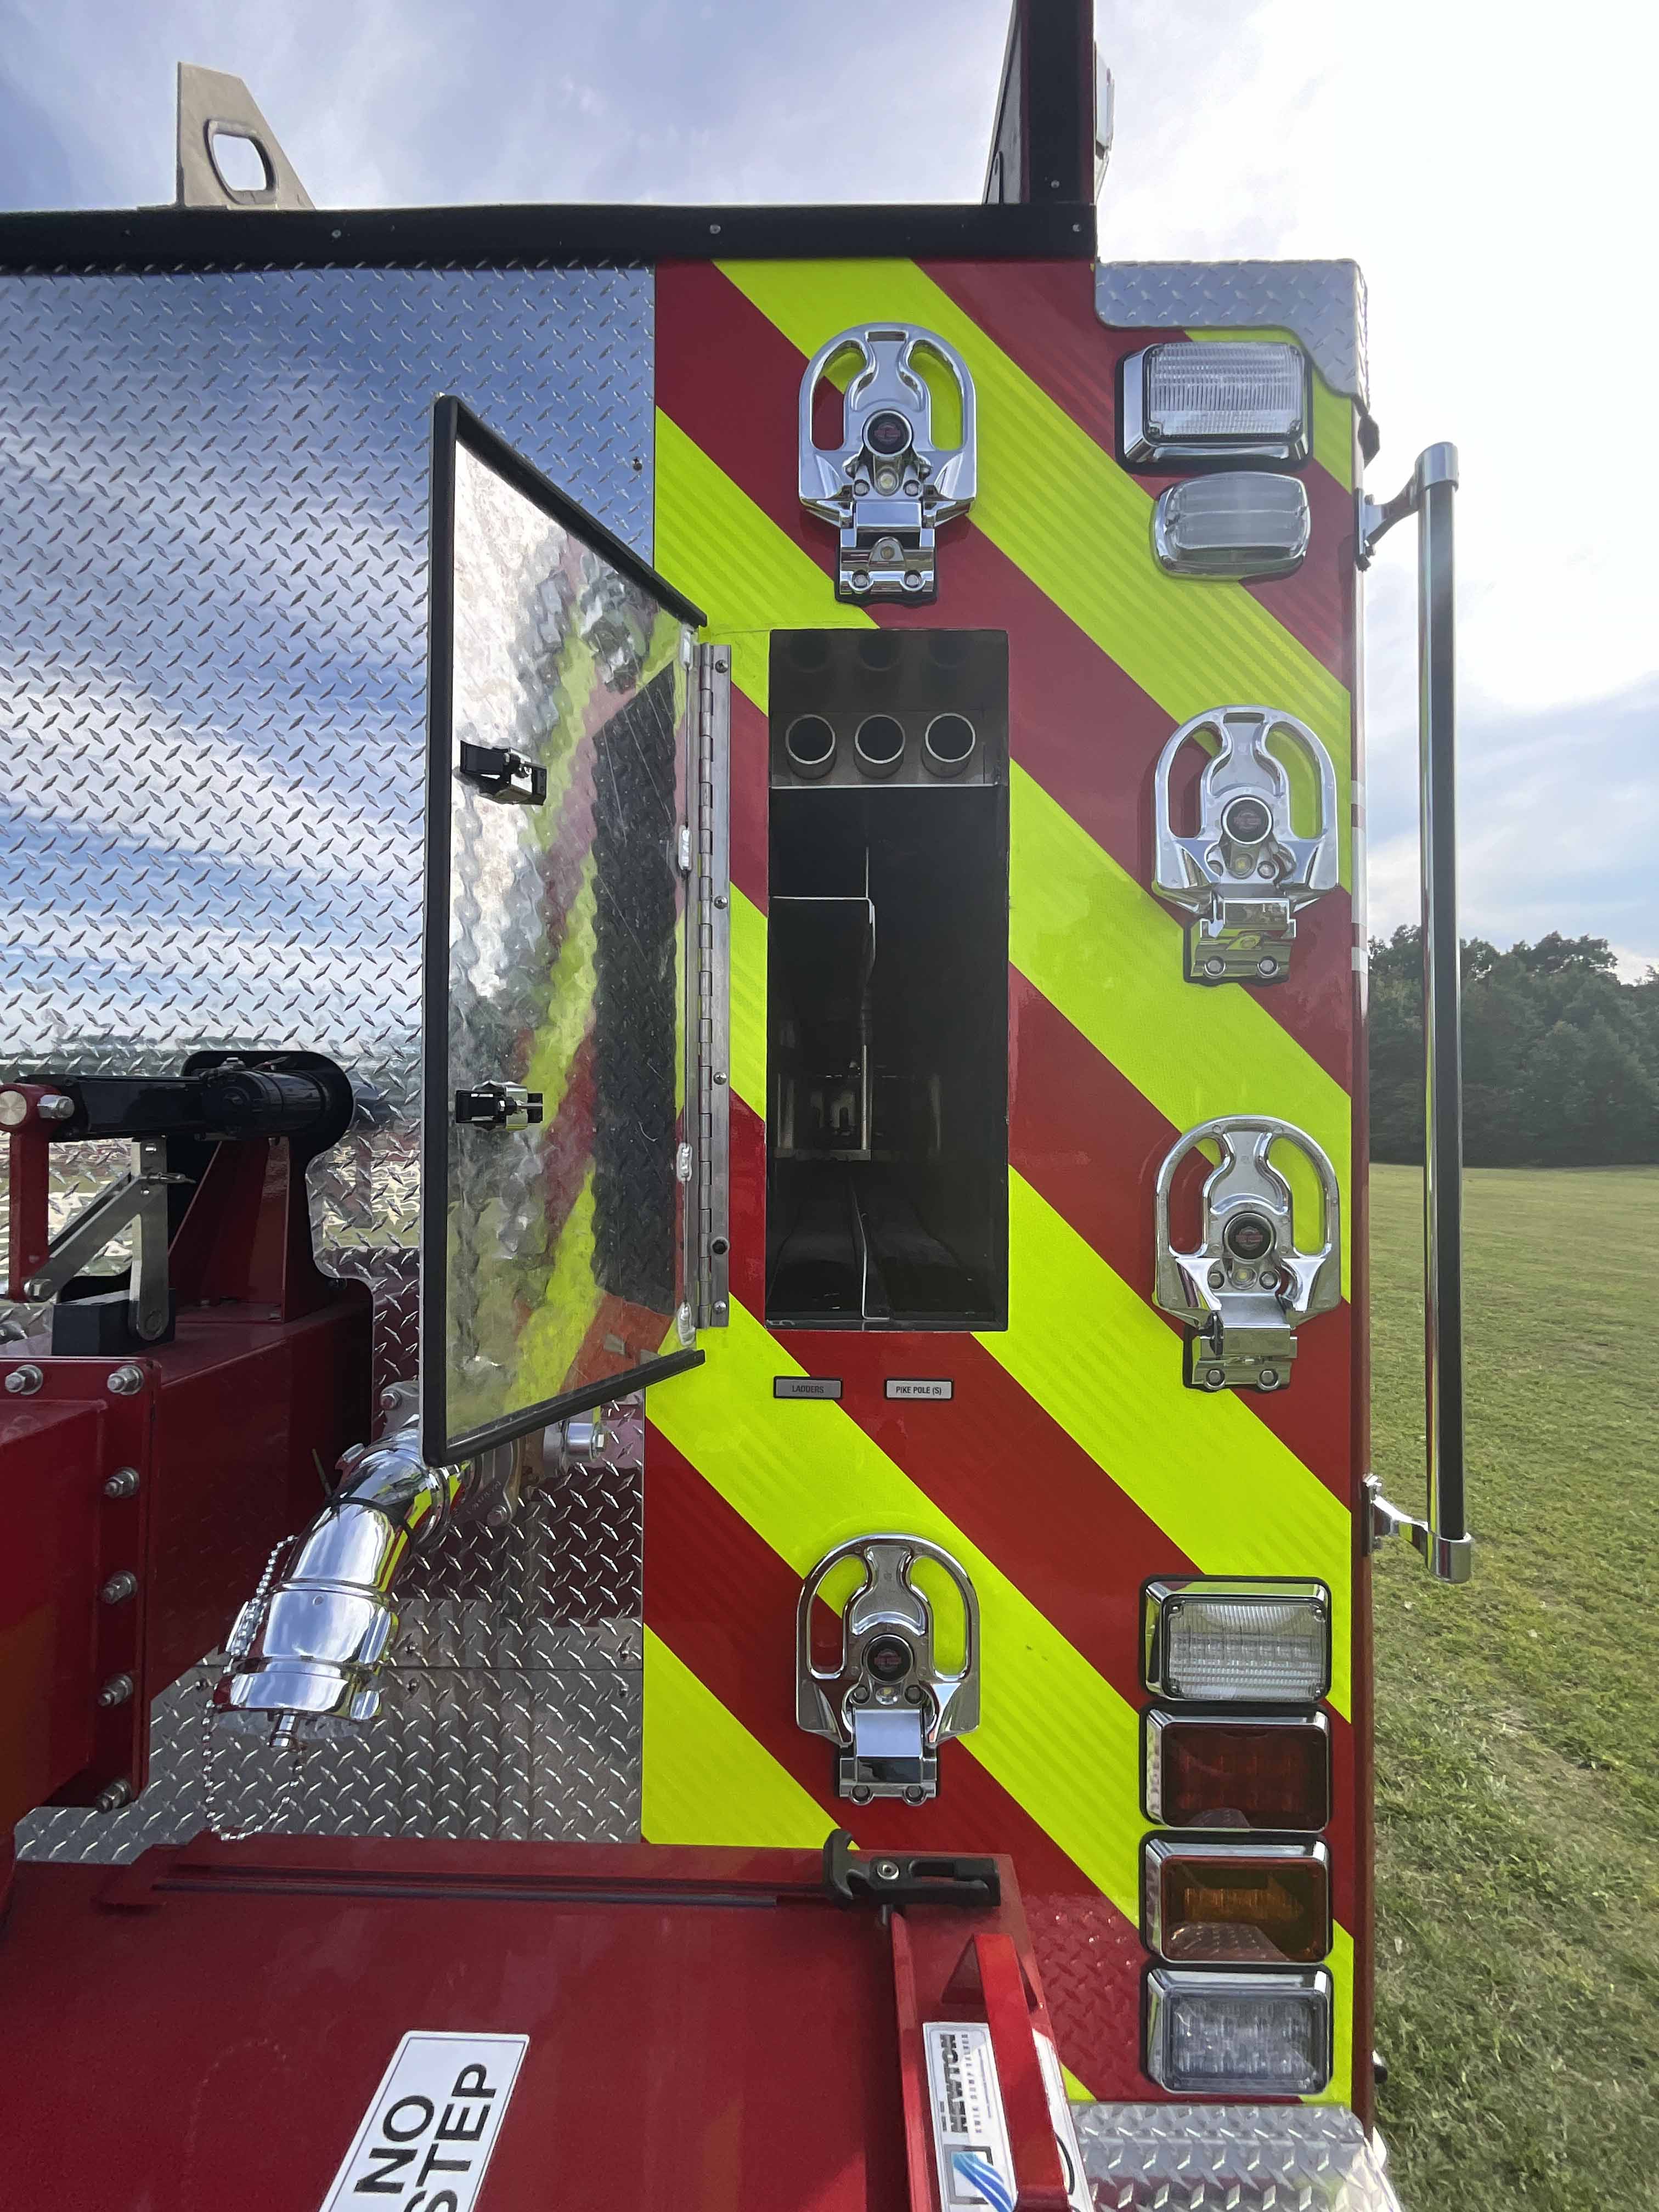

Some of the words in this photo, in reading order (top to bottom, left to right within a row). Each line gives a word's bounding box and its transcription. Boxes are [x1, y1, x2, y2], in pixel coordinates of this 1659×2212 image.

[792, 1385, 824, 1393] LADDERS
[895, 1386, 911, 1394] PIKE
[933, 1387, 942, 1395] (S)
[940, 2034, 969, 2132] NEWTON
[354, 2095, 435, 2194] NO
